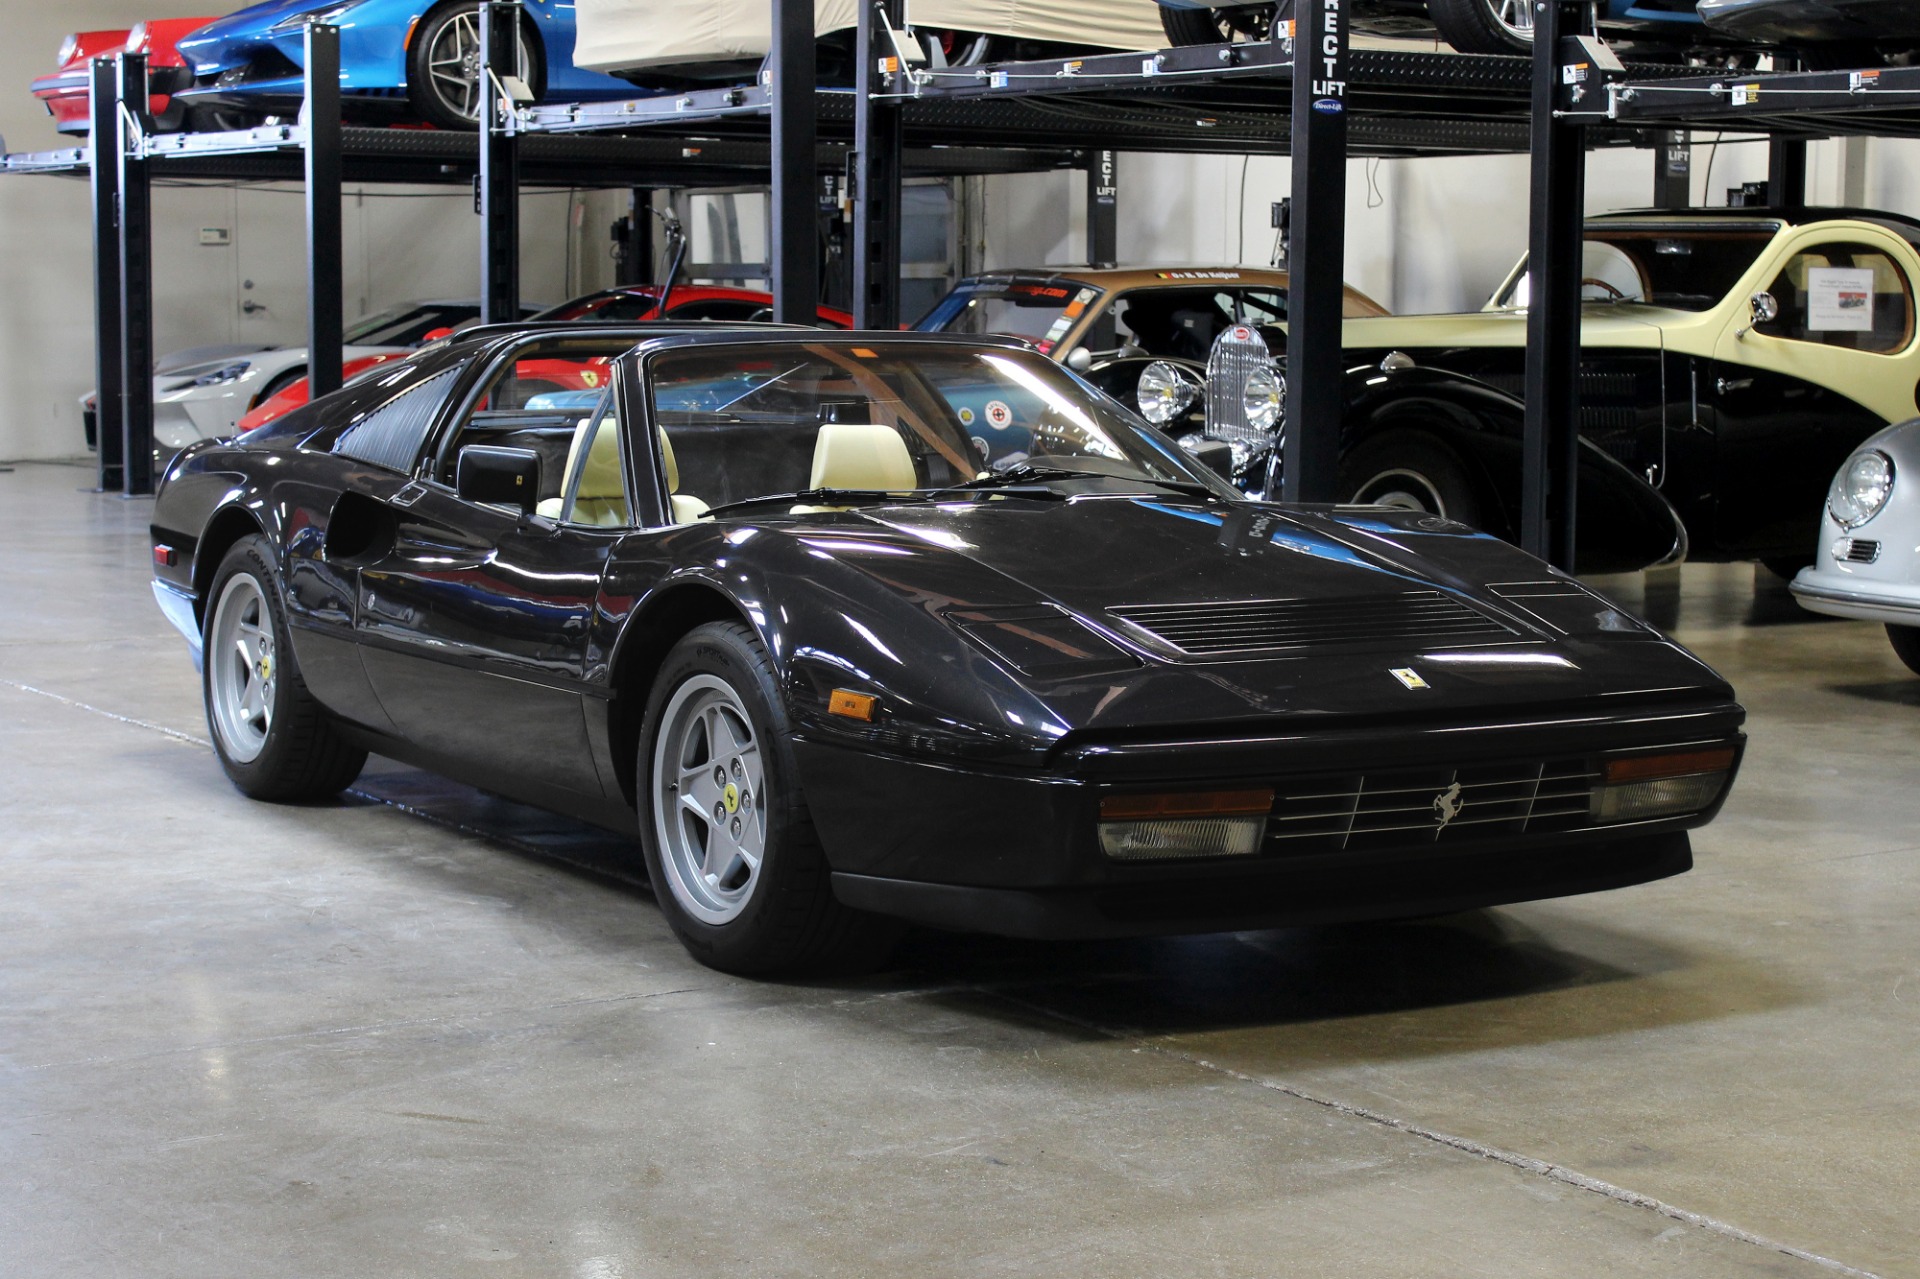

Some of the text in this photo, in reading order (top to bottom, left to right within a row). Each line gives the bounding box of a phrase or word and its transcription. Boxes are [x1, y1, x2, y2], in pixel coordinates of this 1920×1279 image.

[1312, 80, 1346, 96] LIFT
[1668, 150, 1690, 162] LIFT
[1096, 186, 1117, 196] LIFT
